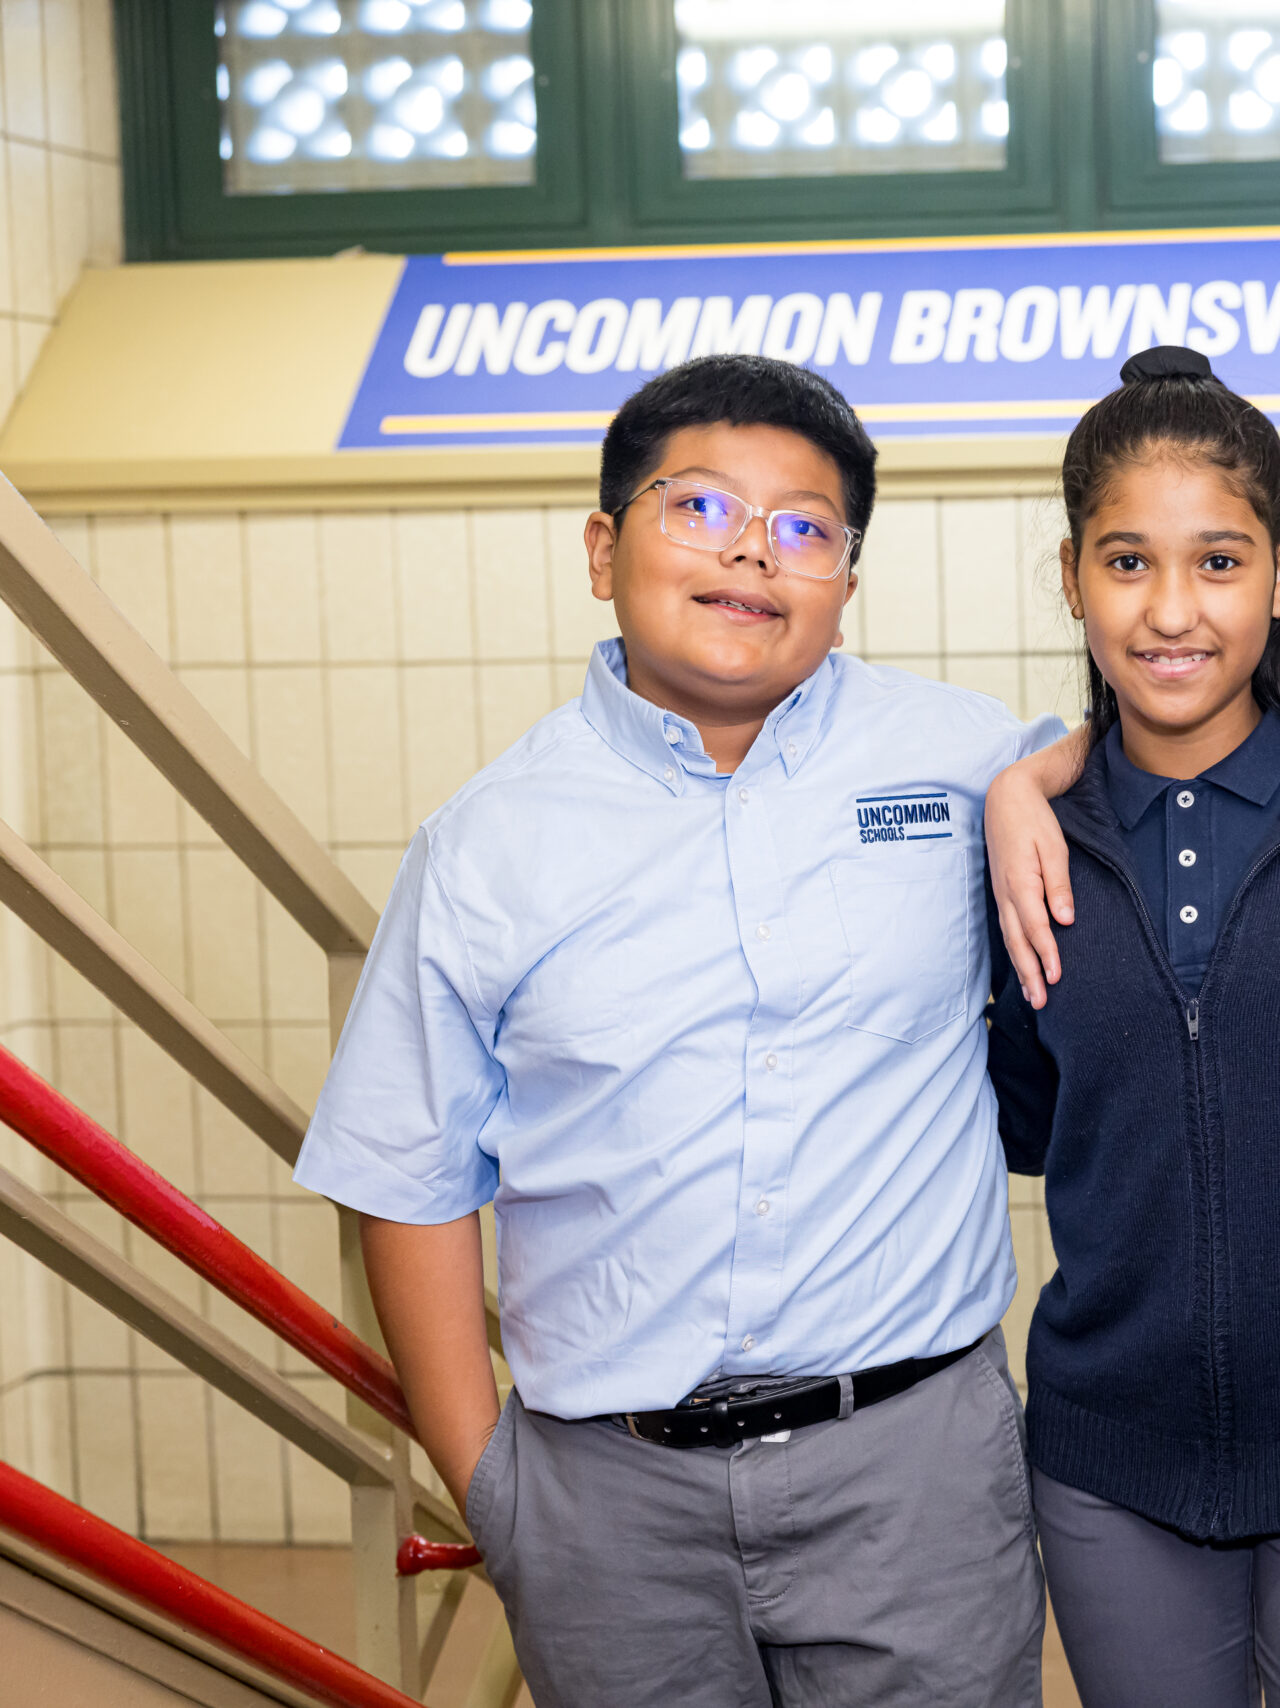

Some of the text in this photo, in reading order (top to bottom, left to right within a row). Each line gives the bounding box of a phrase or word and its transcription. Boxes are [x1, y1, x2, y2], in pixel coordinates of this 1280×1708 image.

[404, 291, 883, 378] UNCOMMON
[857, 802, 950, 828] UNCOMMON
[860, 826, 905, 844] SCHOOLS
